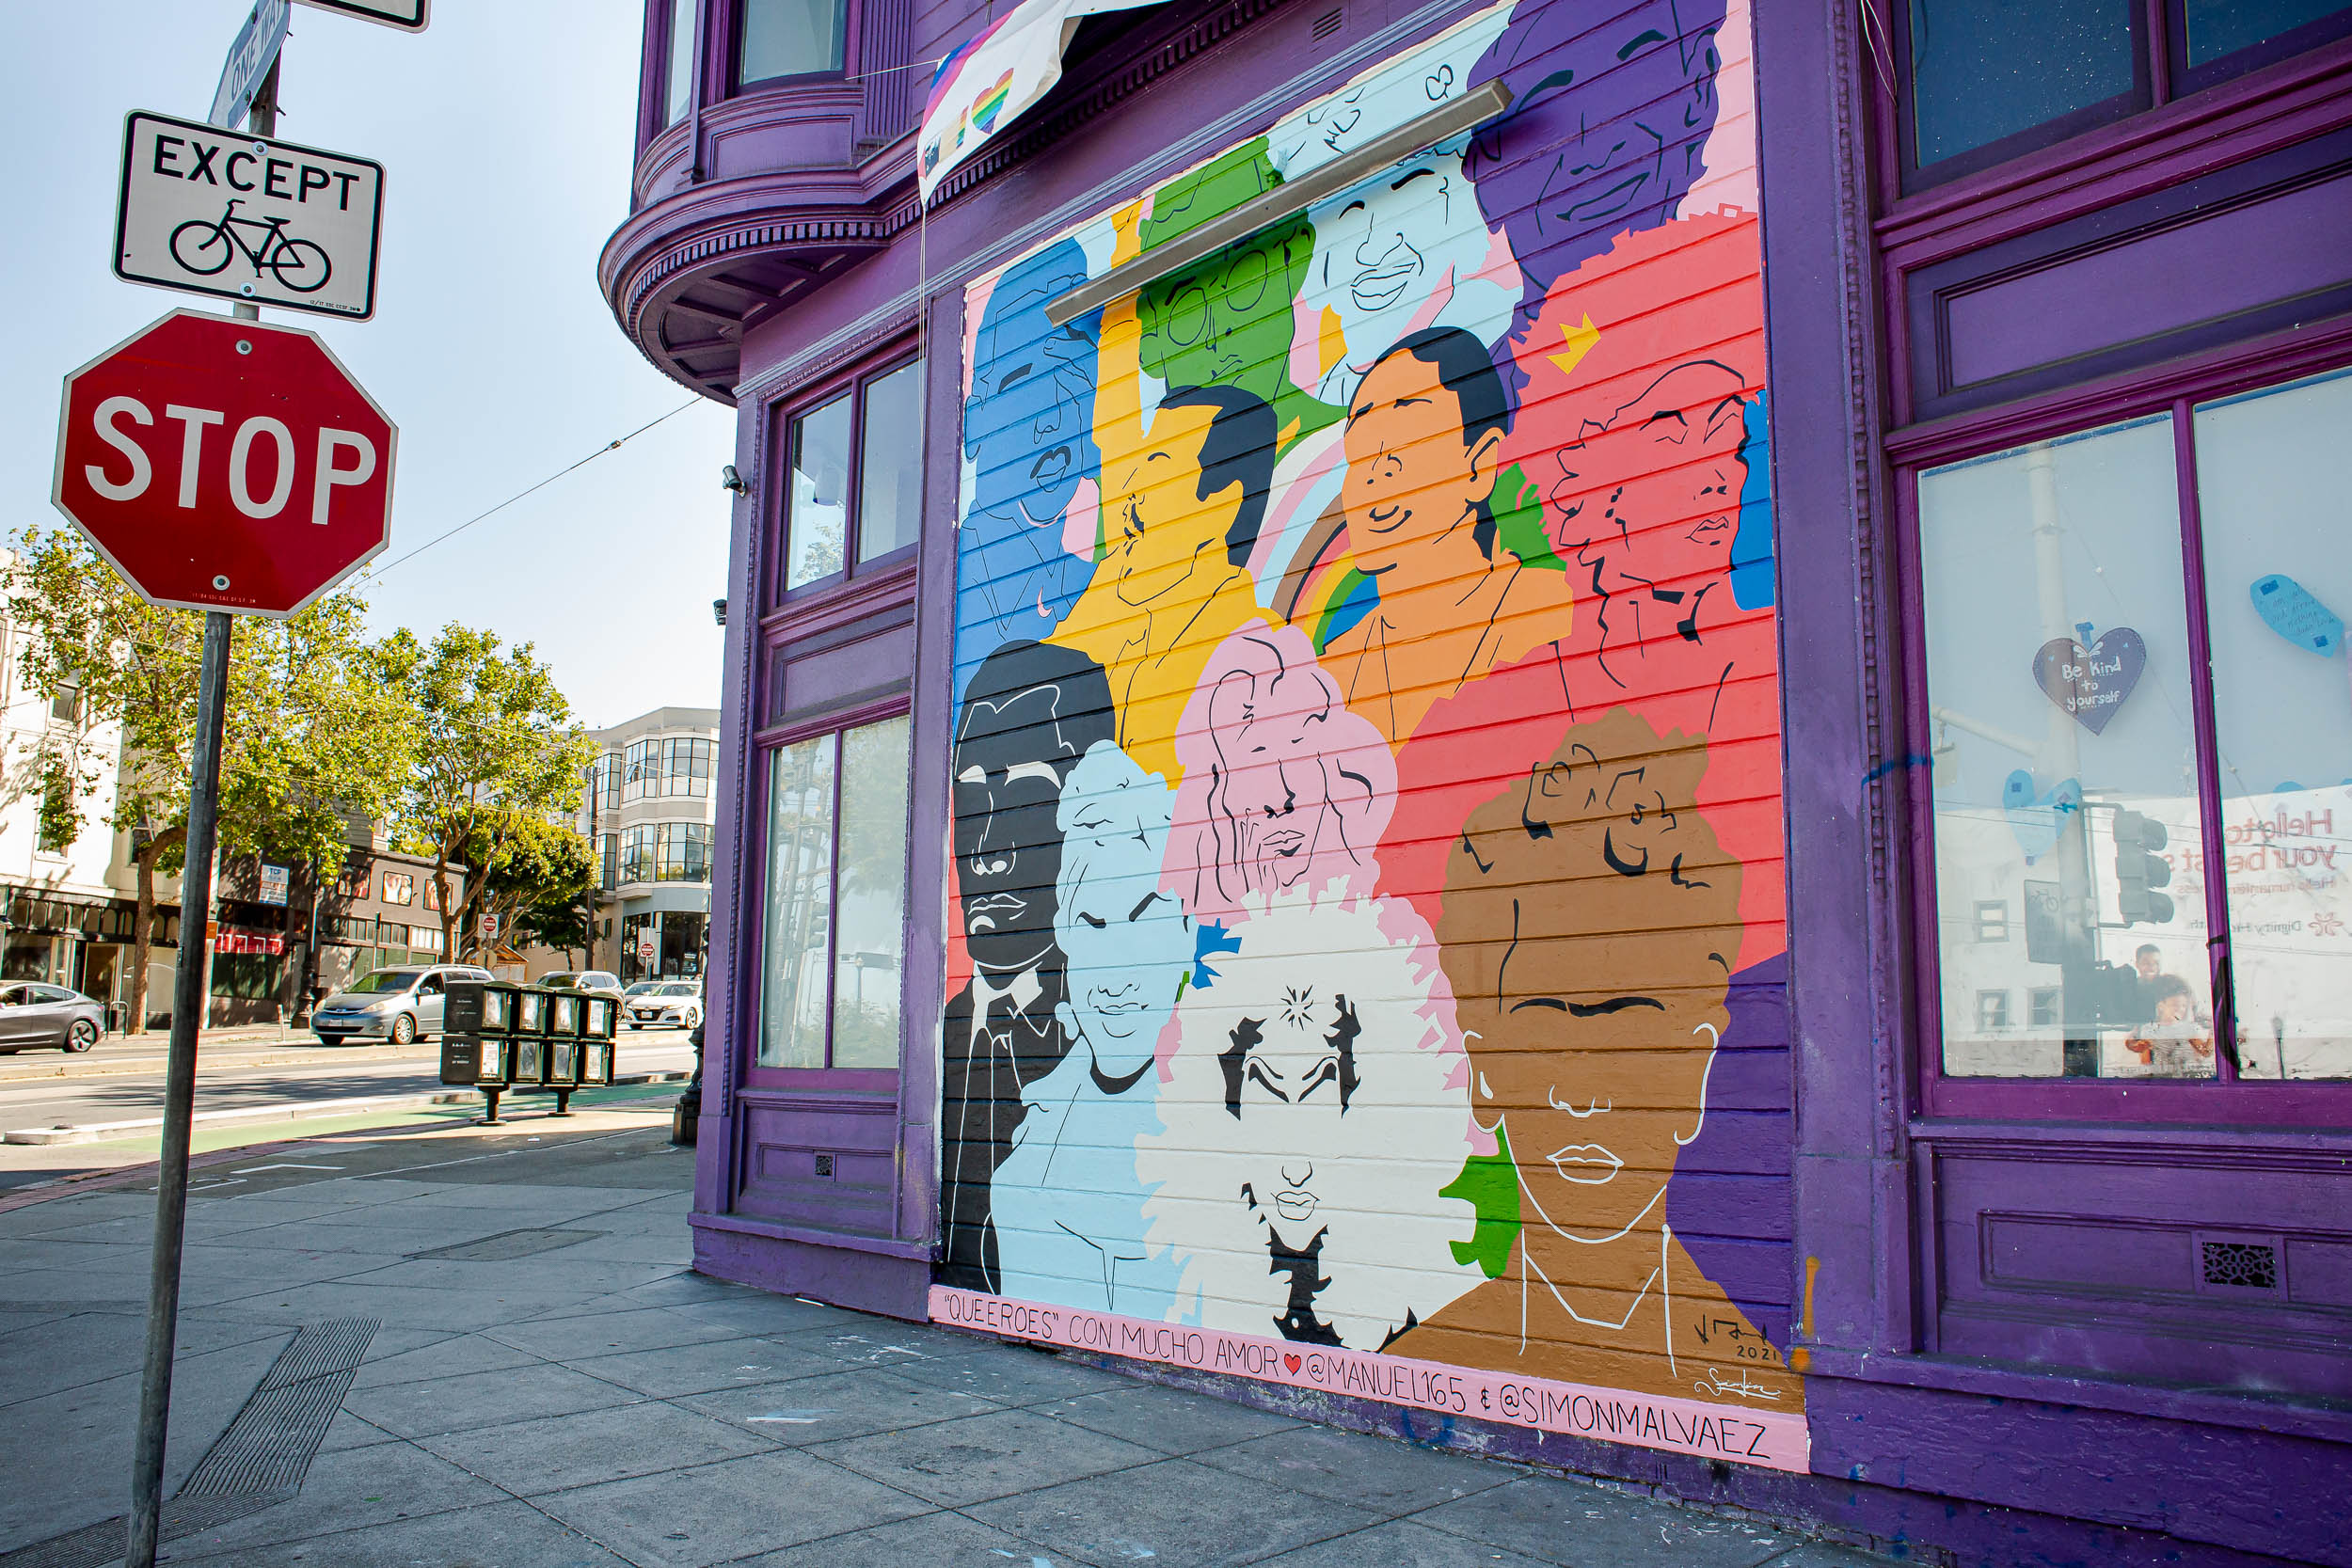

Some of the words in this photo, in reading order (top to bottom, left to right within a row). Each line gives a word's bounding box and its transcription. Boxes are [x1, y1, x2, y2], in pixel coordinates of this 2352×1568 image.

[232, 31, 258, 102] ONE
[153, 134, 359, 211] EXCEPT
[85, 395, 376, 525] STOP
[2061, 663, 2083, 680] Be
[2080, 679, 2099, 692] to
[2066, 690, 2121, 712] yourself
[1737, 1345, 1776, 1361] 2021
[1069, 1315, 1113, 1349] CON
[1121, 1323, 1204, 1364] MUCHO
[1215, 1342, 1279, 1378] AMOR
[1307, 1353, 1466, 1412] @MANUEL165
[1500, 1384, 1771, 1460] @SIMONMALVAEZ
